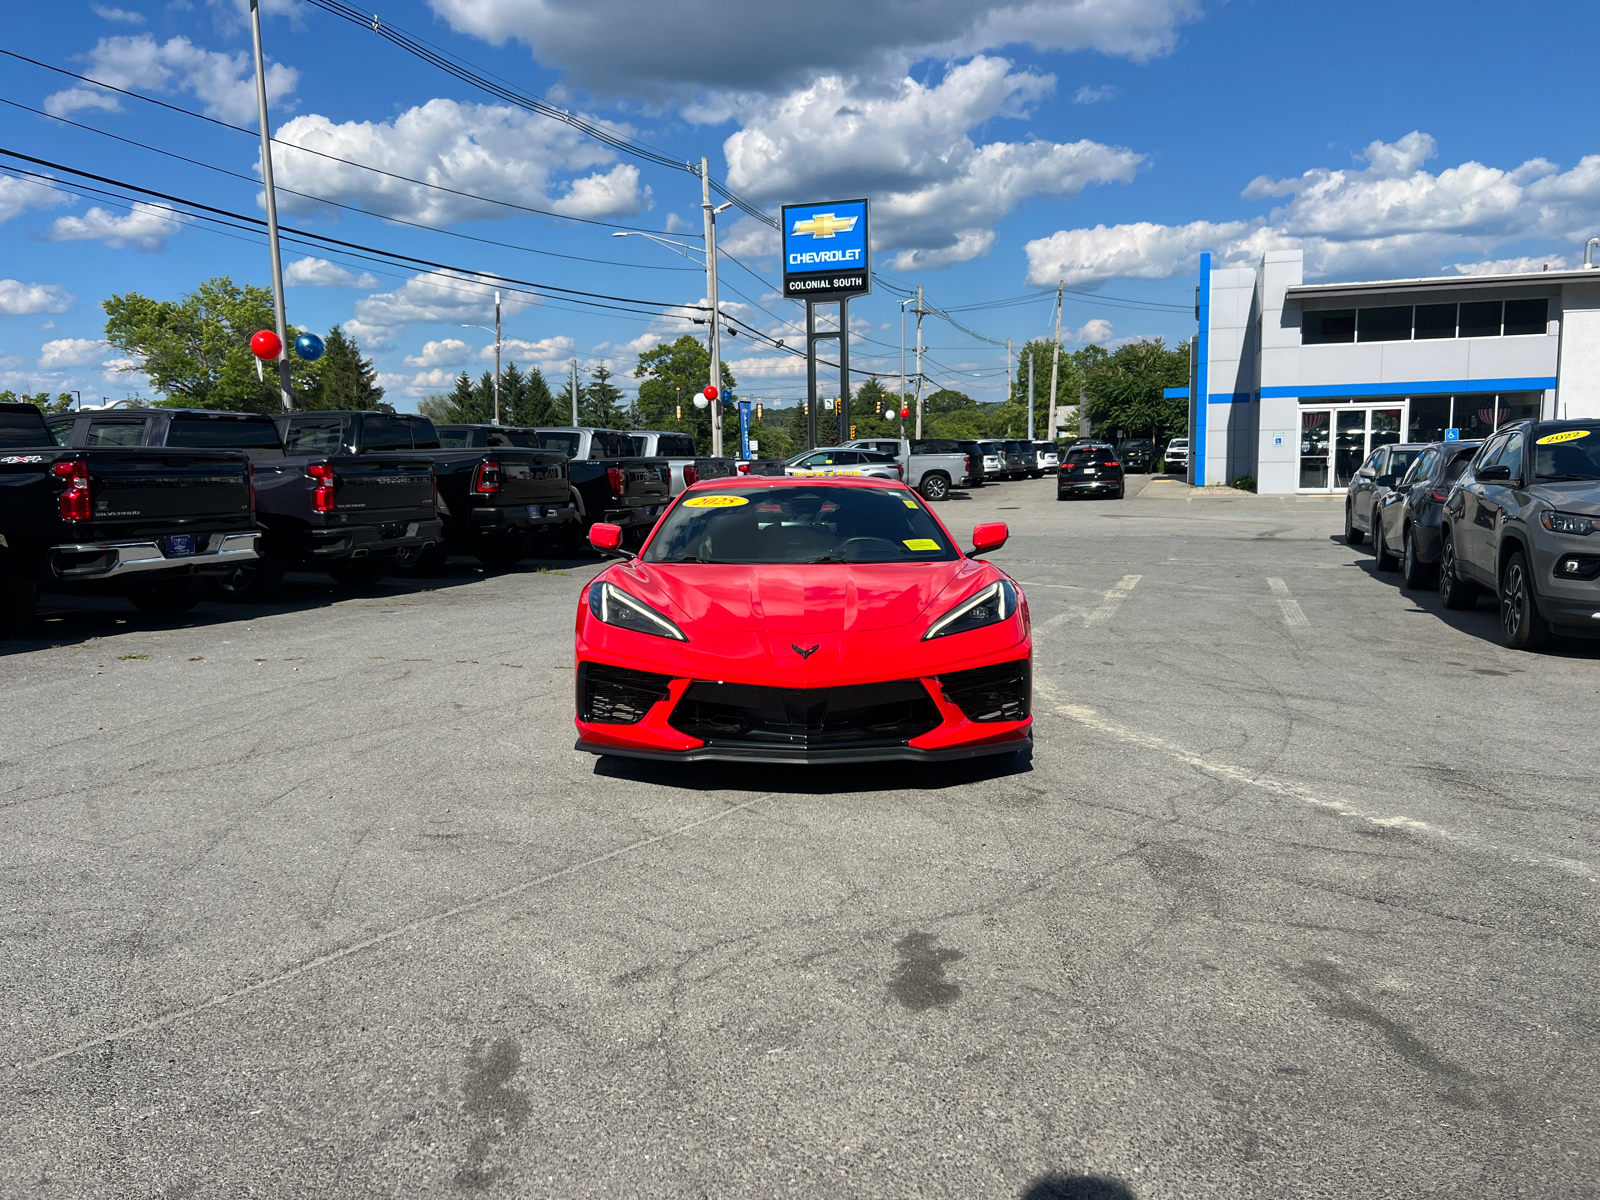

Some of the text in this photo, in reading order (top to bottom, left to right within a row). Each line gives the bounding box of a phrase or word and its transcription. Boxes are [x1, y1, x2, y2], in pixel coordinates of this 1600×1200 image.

[789, 248, 861, 265] CHEVROLET
[789, 277, 862, 290] COLONIAL SOUTH
[1547, 431, 1580, 443] 2022
[692, 498, 740, 506] 2025
